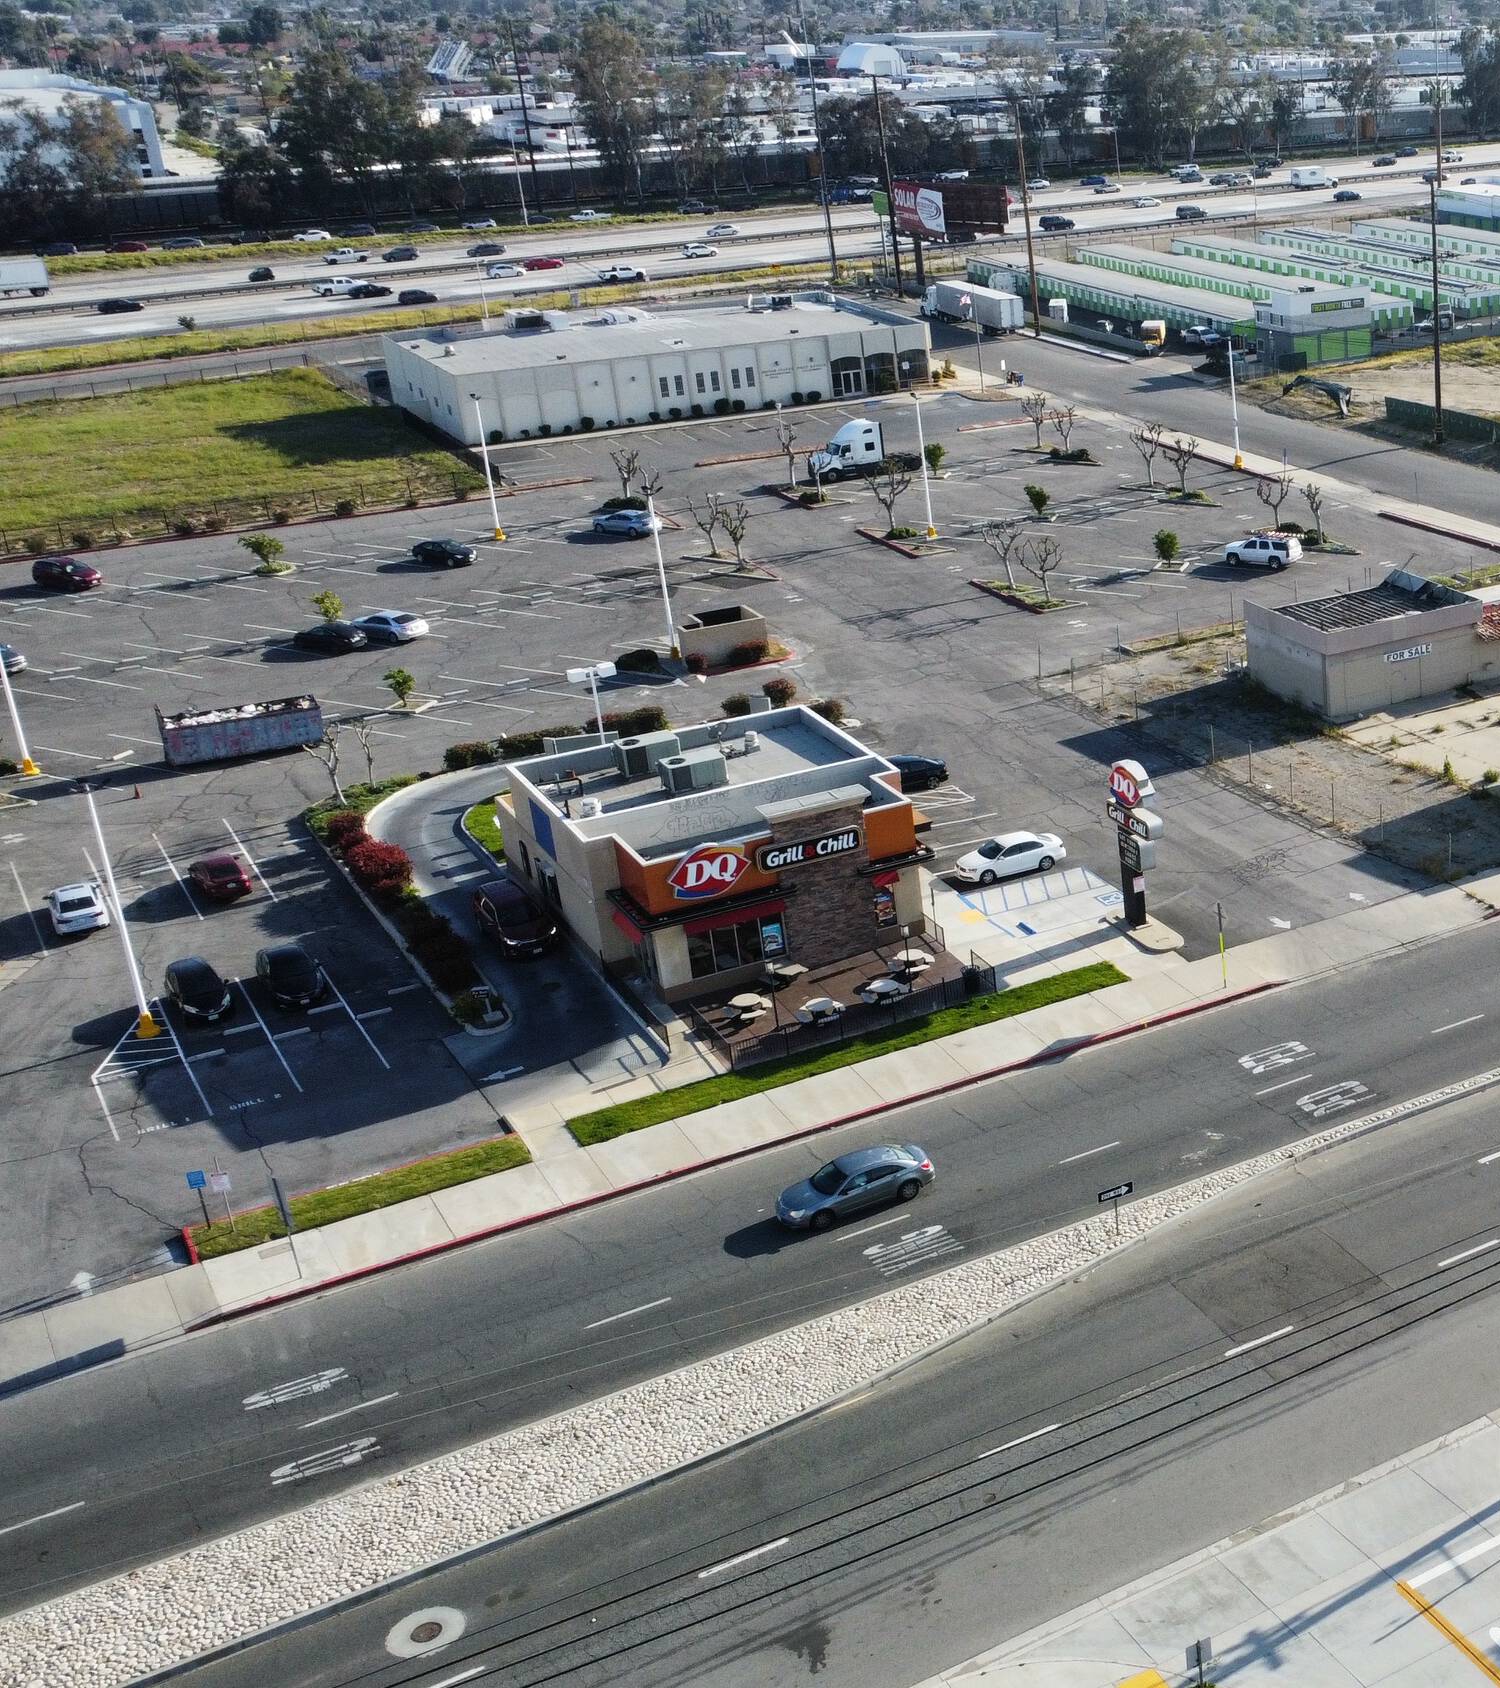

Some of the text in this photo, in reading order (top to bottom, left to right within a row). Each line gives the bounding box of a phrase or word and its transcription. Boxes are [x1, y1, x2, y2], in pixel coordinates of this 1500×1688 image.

[894, 188, 916, 210] SOLAR
[1386, 644, 1432, 662] FOR SALE
[1114, 772, 1136, 802] DQ
[1108, 806, 1124, 824] Grill
[1129, 818, 1146, 837] Chill
[766, 846, 804, 868] Grill
[816, 832, 858, 856] Chill
[684, 853, 738, 889] DQ
